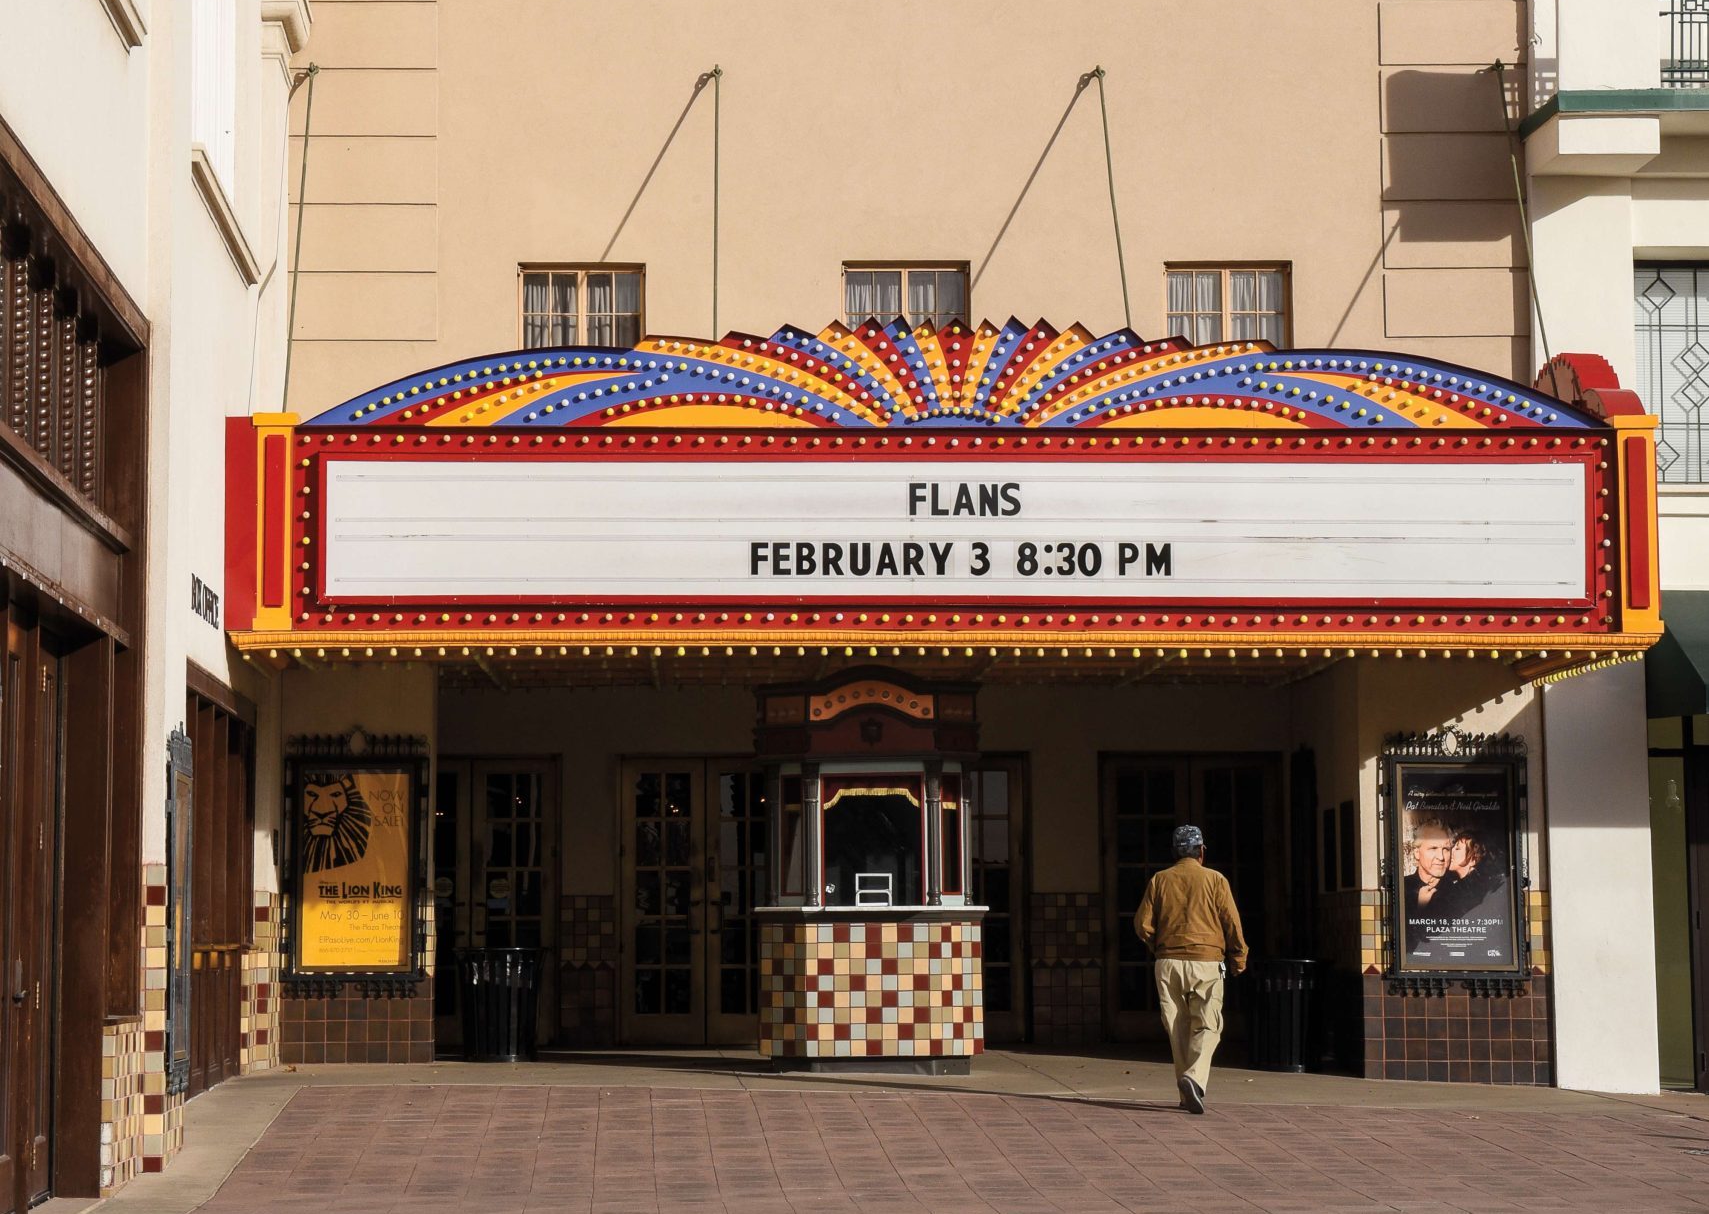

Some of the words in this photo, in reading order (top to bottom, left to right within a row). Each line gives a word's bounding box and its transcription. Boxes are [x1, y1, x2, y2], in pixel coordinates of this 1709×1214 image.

[908, 482, 1022, 517] FLANS
[750, 541, 954, 577] FEBRUARY
[969, 541, 991, 577] 3
[1016, 541, 1102, 577] 8:30
[1117, 541, 1172, 577] PM
[191, 572, 203, 617] BOX
[202, 583, 219, 630] OFFICE
[369, 789, 405, 801] NOW
[382, 802, 404, 815] ON
[1405, 800, 1419, 811] Pat
[318, 884, 339, 896] THE
[341, 881, 370, 899] LION
[373, 881, 403, 899] KING
[320, 910, 342, 922] May
[346, 910, 360, 920] 30
[371, 910, 390, 921] June
[1439, 918, 1450, 926] 18,
